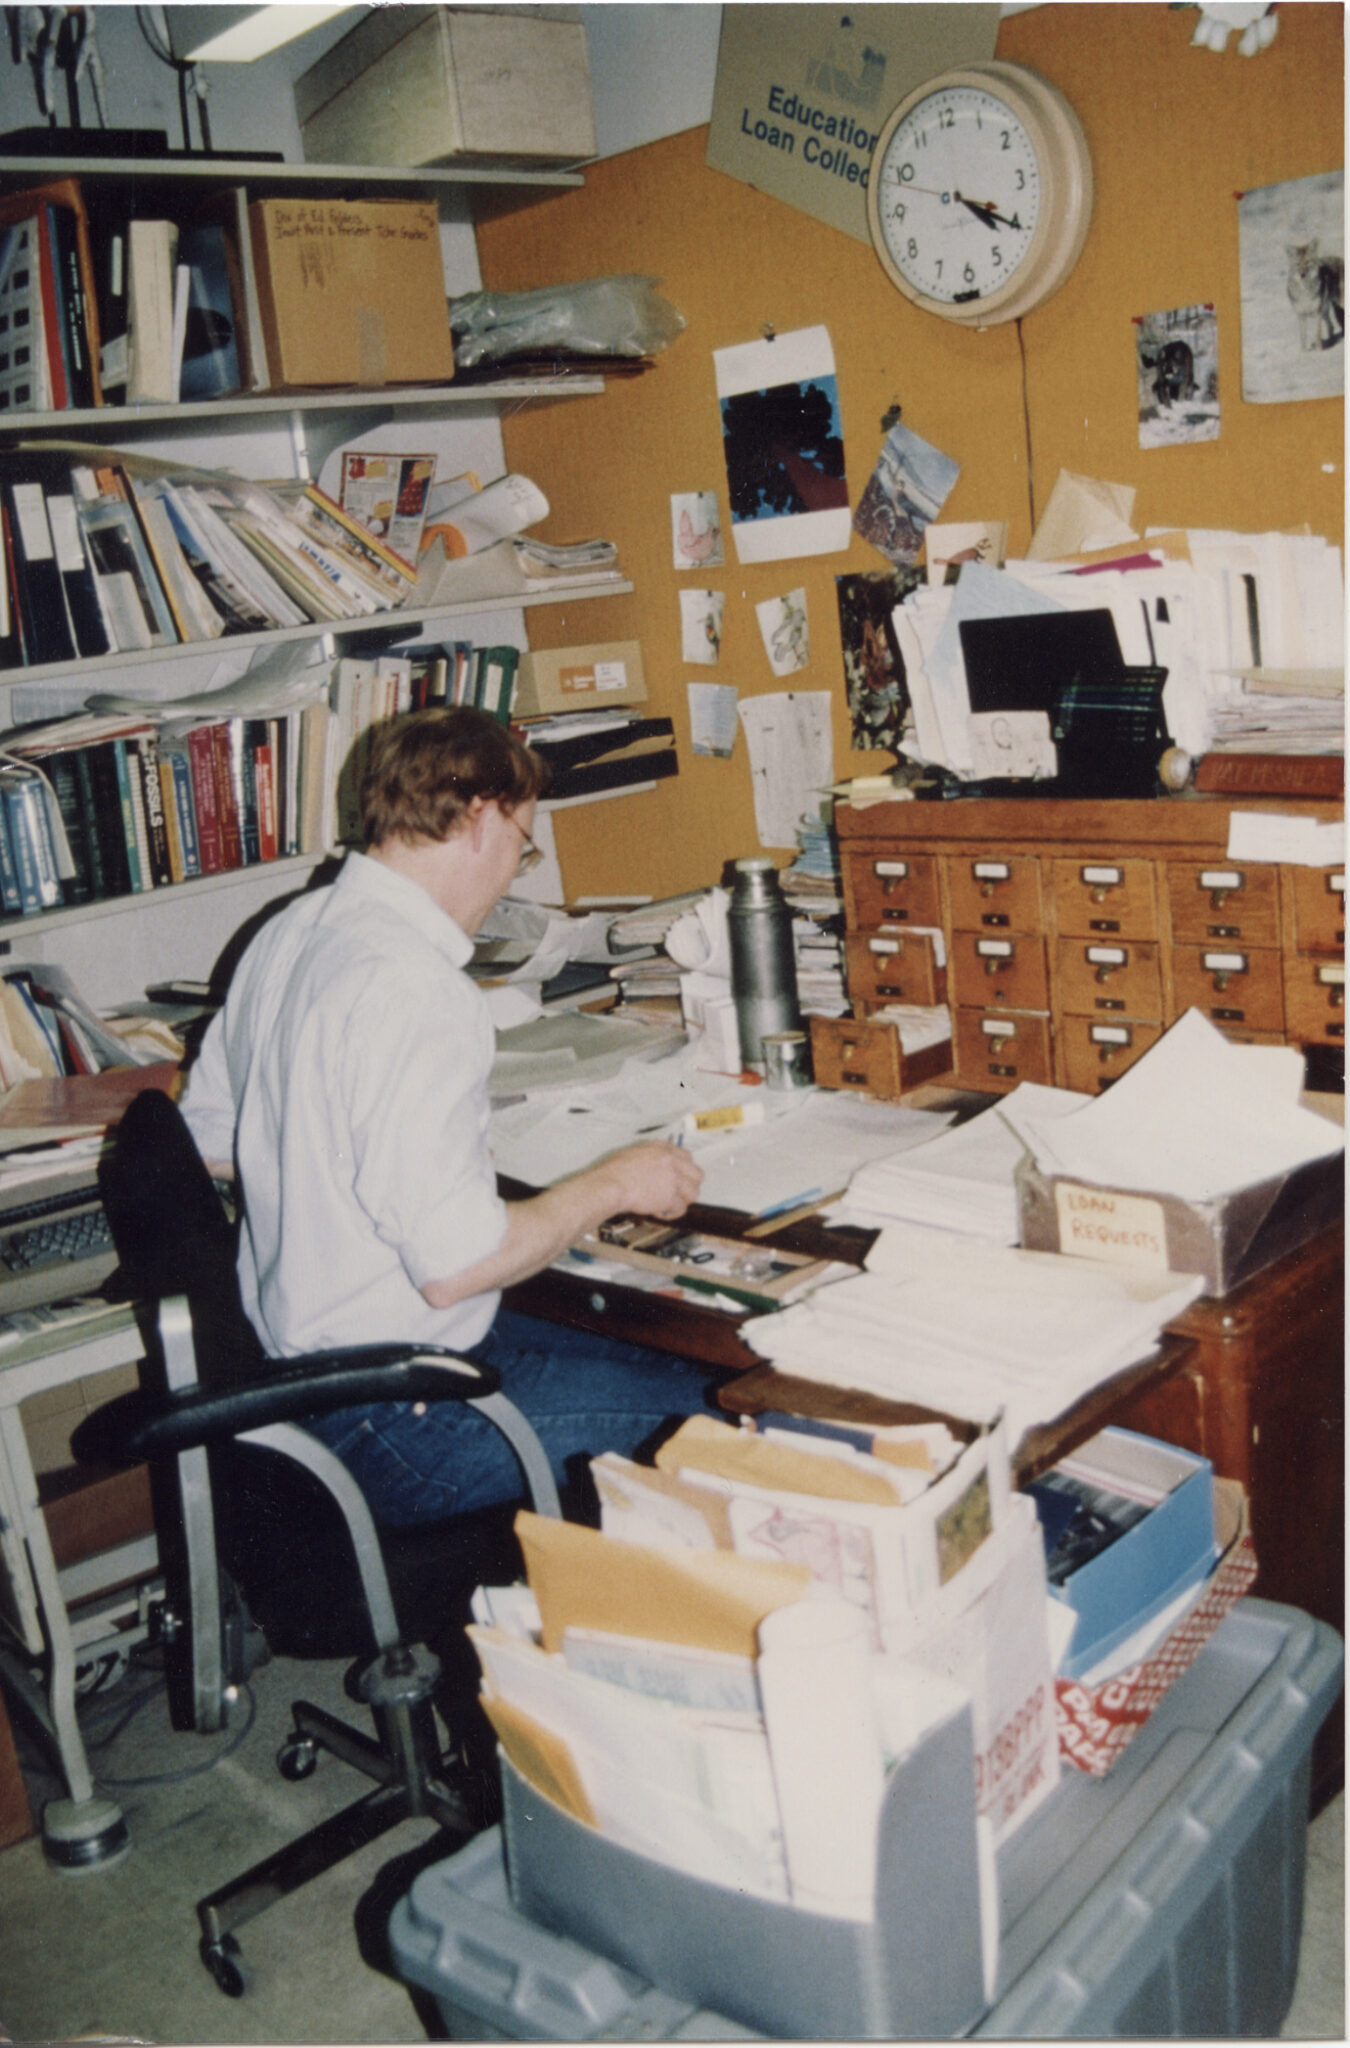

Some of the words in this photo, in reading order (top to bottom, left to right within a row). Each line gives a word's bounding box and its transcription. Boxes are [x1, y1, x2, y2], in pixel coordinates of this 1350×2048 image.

[938, 108, 955, 130] 12
[976, 109, 982, 130] 1
[741, 107, 795, 154] Loan
[914, 130, 928, 150] 11
[1000, 130, 1011, 150] 2
[896, 163, 915, 183] 10
[1015, 169, 1025, 191] 3
[894, 203, 906, 224] 9
[907, 238, 918, 260] 8
[991, 246, 1002, 267] 5
[934, 260, 944, 280] 7
[963, 261, 975, 283] 6
[145, 763, 164, 828] FOSSILS
[1067, 1193, 1116, 1215] LOAN
[1071, 1217, 1160, 1254] REQUESTS
